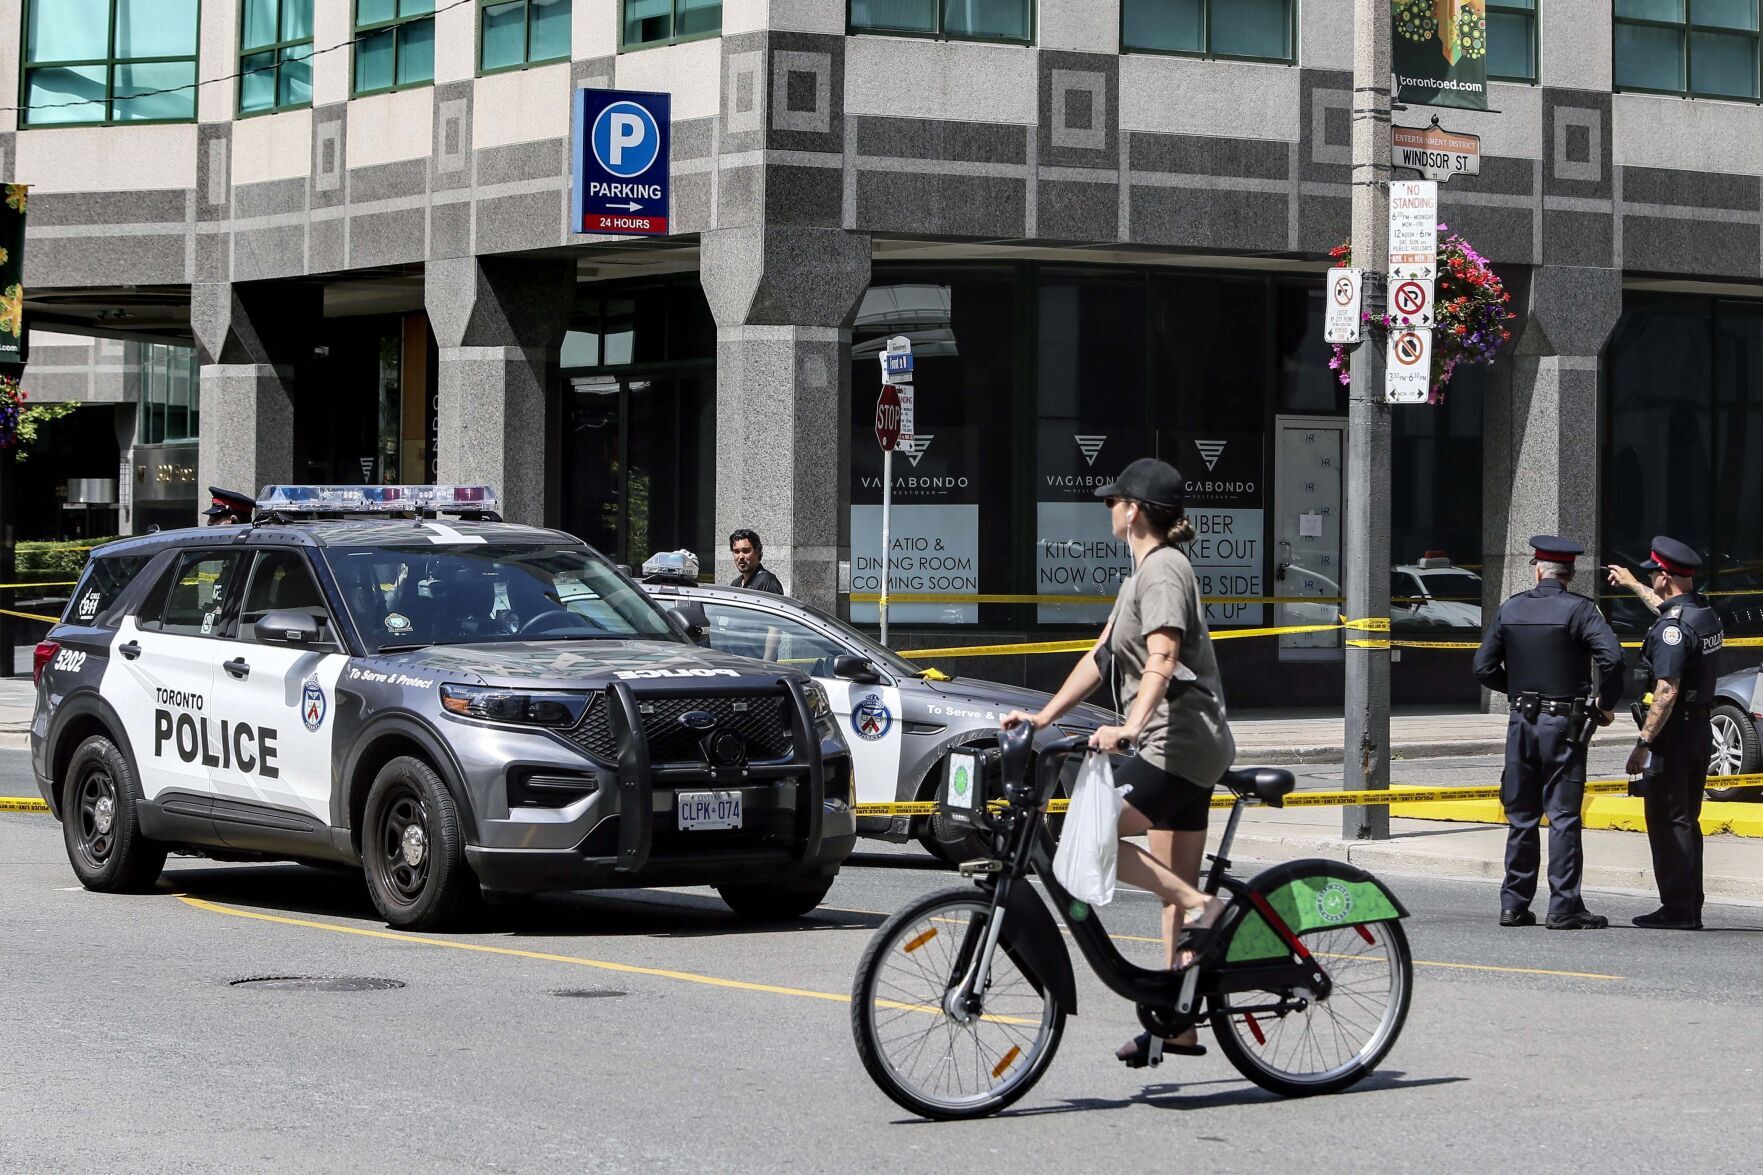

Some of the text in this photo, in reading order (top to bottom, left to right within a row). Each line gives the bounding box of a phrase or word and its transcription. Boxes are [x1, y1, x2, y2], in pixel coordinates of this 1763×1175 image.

[1400, 75, 1482, 92] torontoed.com
[610, 112, 645, 165] P
[1403, 149, 1469, 172] WINDSOR ST.
[590, 182, 661, 199] PARKING
[1406, 184, 1420, 196] NO
[1392, 198, 1434, 209] STANDING
[600, 217, 650, 229] 24 HOURS
[878, 404, 900, 430] STOP
[861, 477, 968, 488] VAABONDO
[1046, 476, 1120, 486] VAGABON
[1184, 481, 1254, 492] GABONDO
[889, 538, 944, 552] ATIO &
[1046, 542, 1116, 558] KITCHEN
[1180, 540, 1256, 559] KE OUT
[857, 557, 972, 570] DINNG ROOM
[928, 576, 976, 590] SOON
[1040, 566, 1132, 584] NOW OPE
[1219, 576, 1260, 595] SIDE
[82, 600, 99, 614] 911
[54, 650, 86, 672] 5202
[349, 668, 433, 688] To Serve & Protect
[156, 687, 204, 710] TORONTO
[927, 704, 942, 714] To
[946, 706, 981, 719] Serve
[986, 711, 995, 720] &
[154, 708, 280, 779] POLICE
[682, 801, 740, 820] CLPK 074
